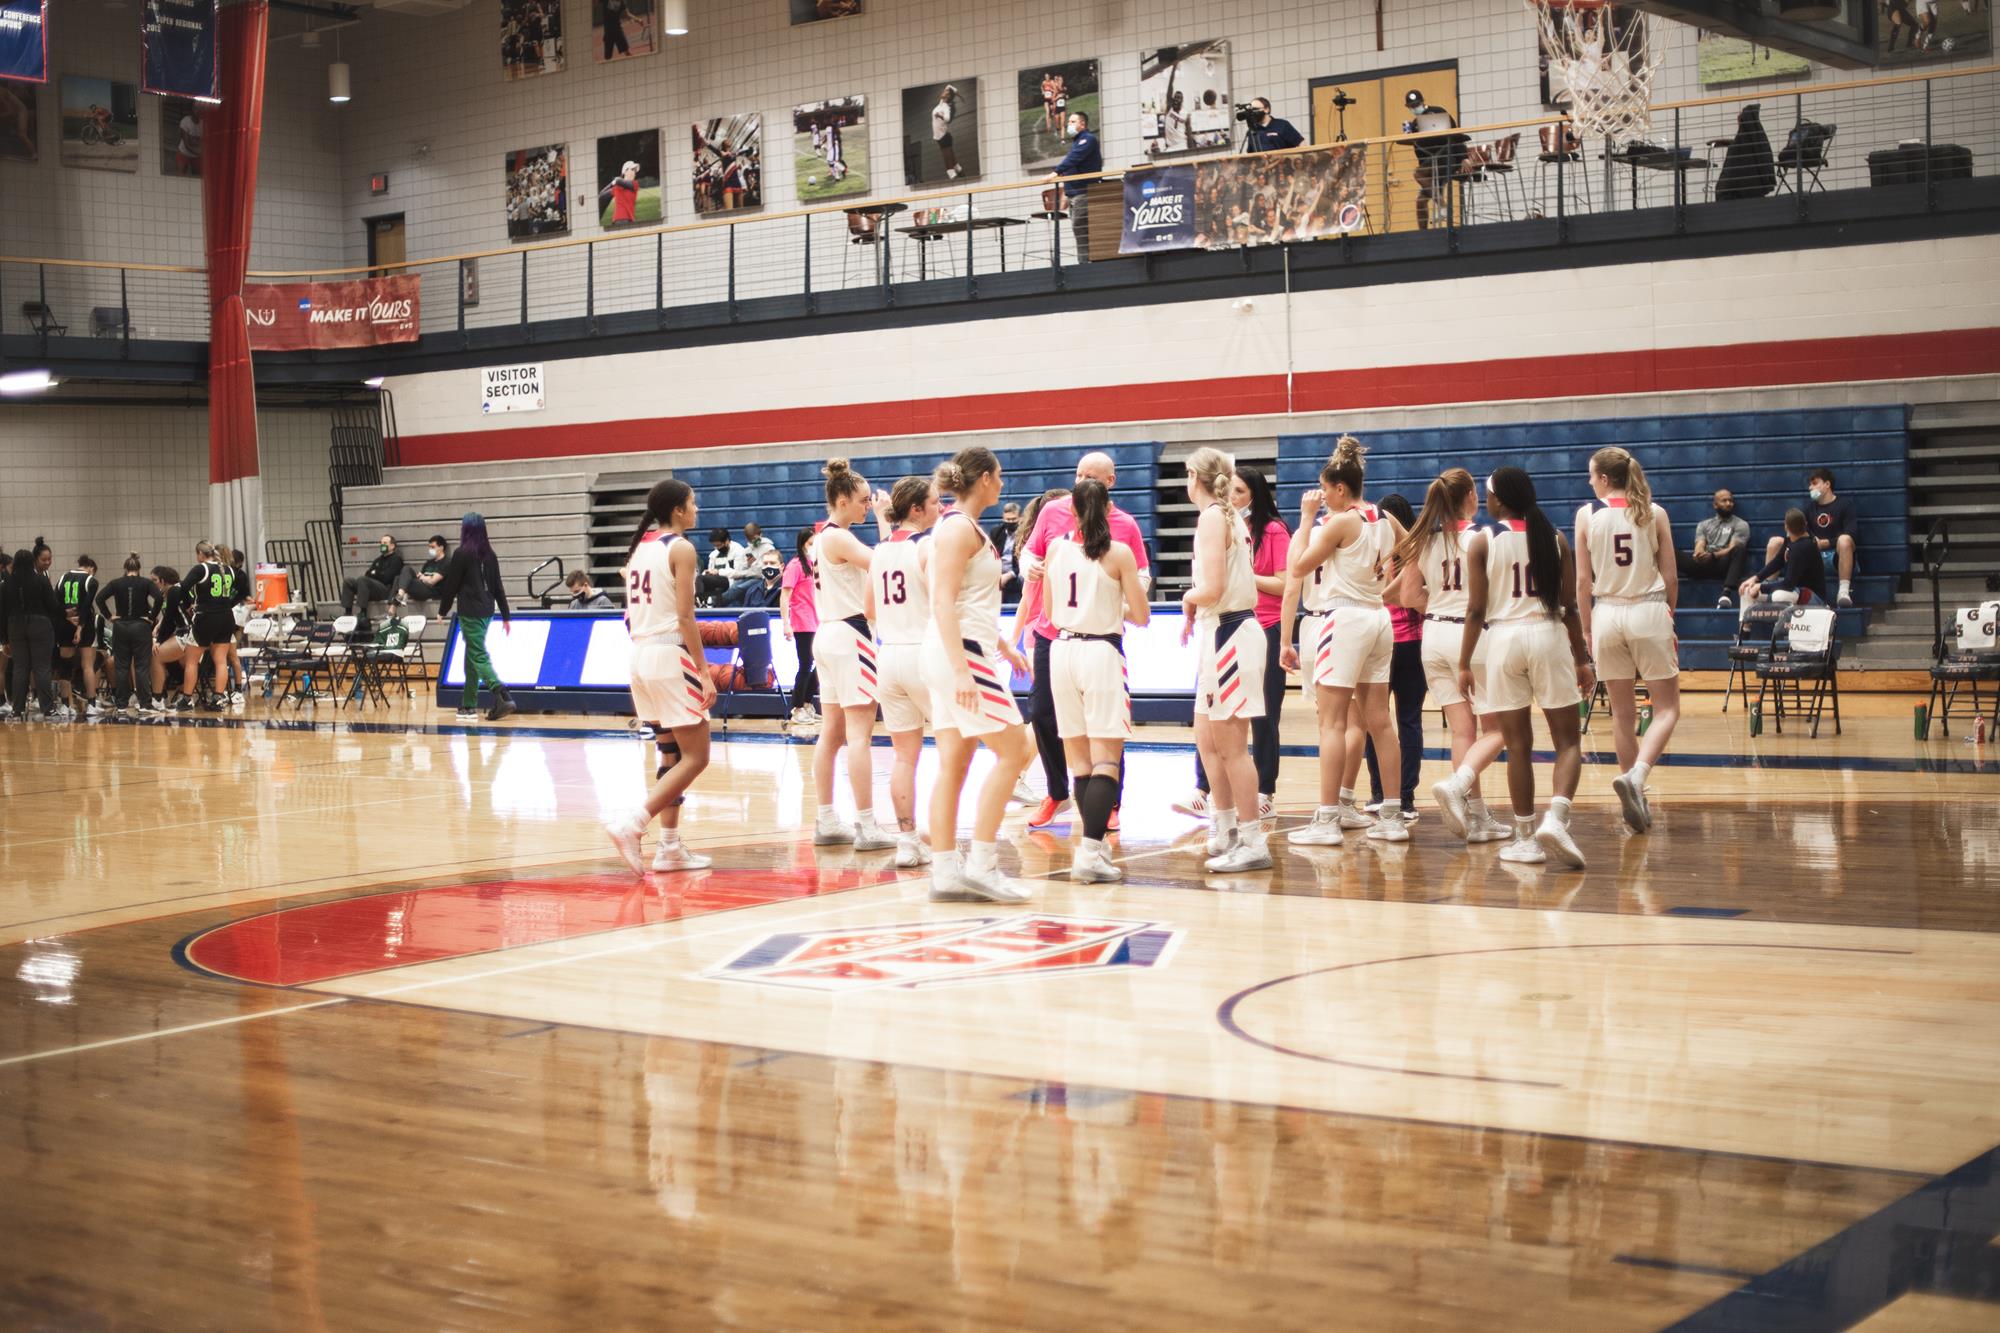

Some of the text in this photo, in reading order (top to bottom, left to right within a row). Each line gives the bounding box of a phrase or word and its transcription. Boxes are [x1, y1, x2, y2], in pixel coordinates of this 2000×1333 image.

[1149, 195, 1184, 206] MAKE IT
[1131, 201, 1183, 232] YOURS
[246, 309, 275, 326] NU
[310, 295, 411, 323] MAKE IT YOURS
[488, 367, 537, 382] VISITOR
[486, 382, 539, 398] SECTION
[1614, 534, 1633, 567] 5
[630, 570, 652, 604] 24
[882, 570, 907, 605] 13
[1442, 558, 1462, 591] 11
[64, 581, 79, 604] 11
[1067, 572, 1078, 608] 1
[1641, 710, 1650, 719] G
